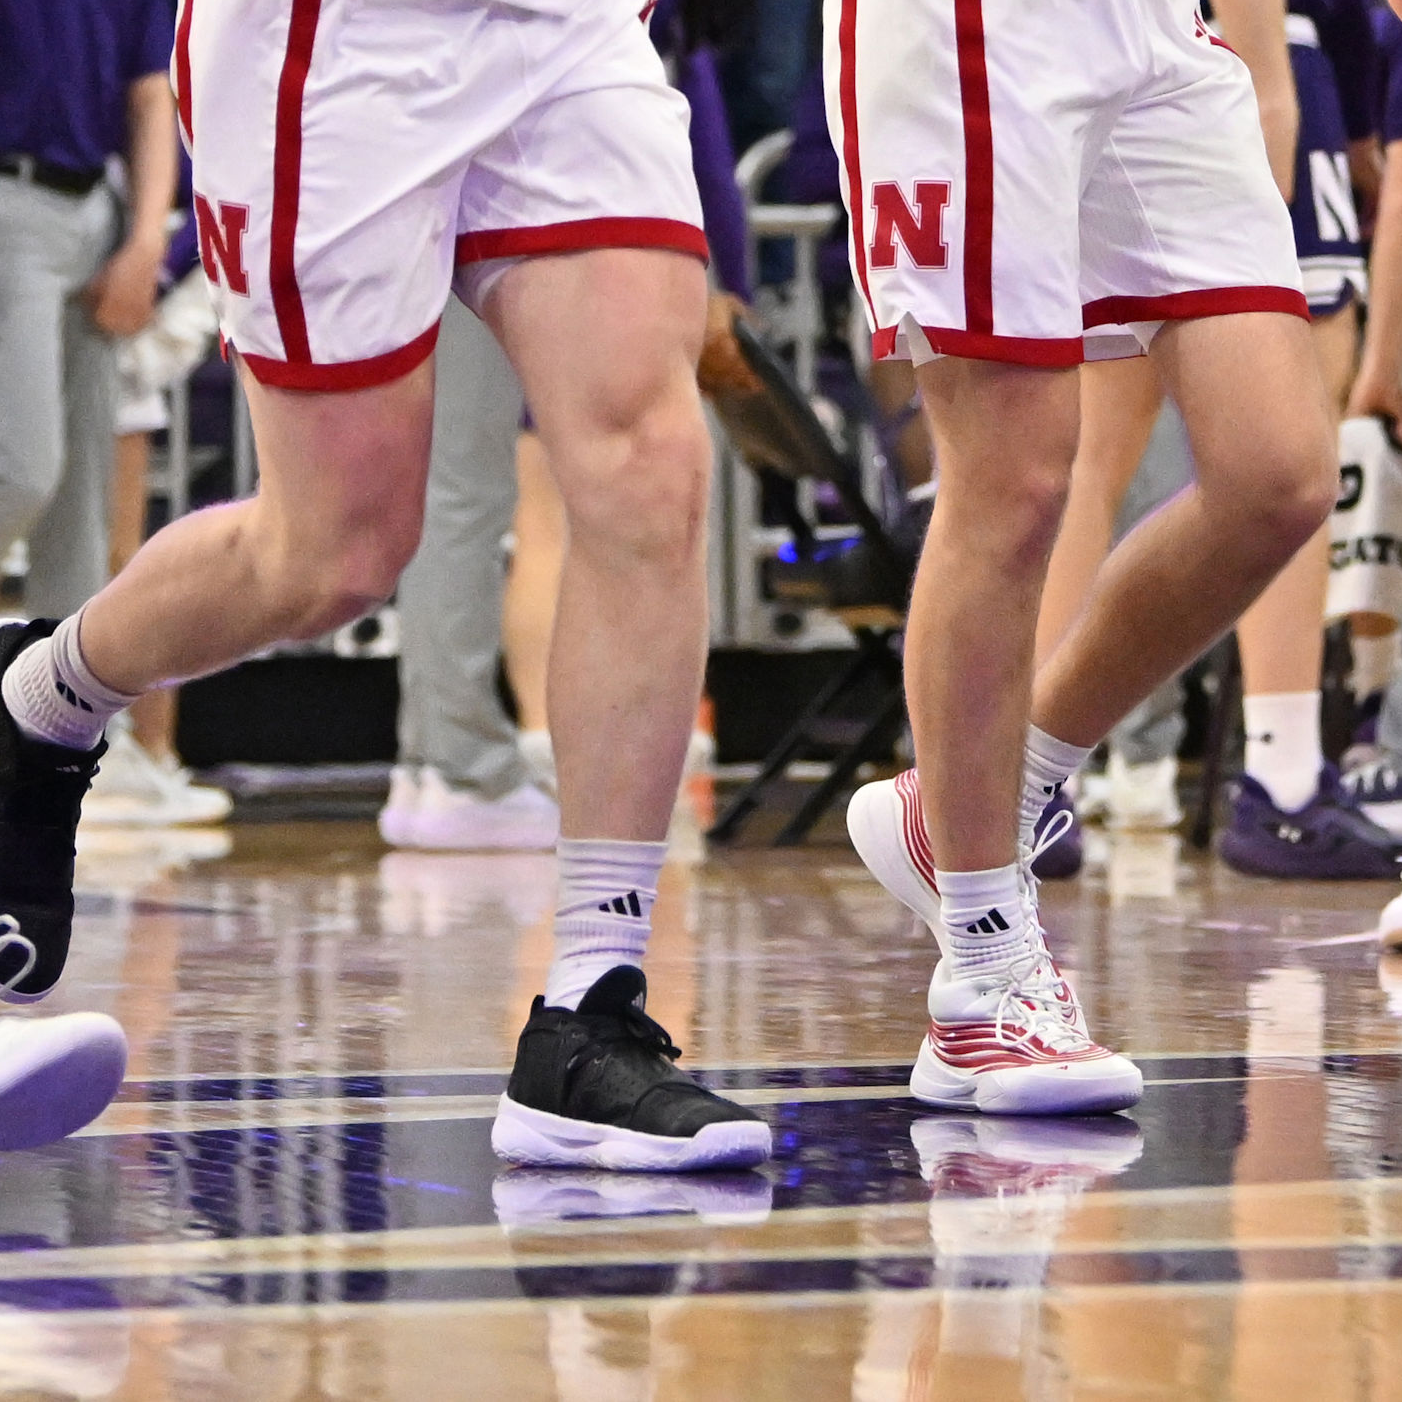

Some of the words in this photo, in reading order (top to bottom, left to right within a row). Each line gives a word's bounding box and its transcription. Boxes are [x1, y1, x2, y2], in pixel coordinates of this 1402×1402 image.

[193, 189, 251, 299] N
[869, 181, 951, 271] N
[1309, 149, 1361, 244] N
